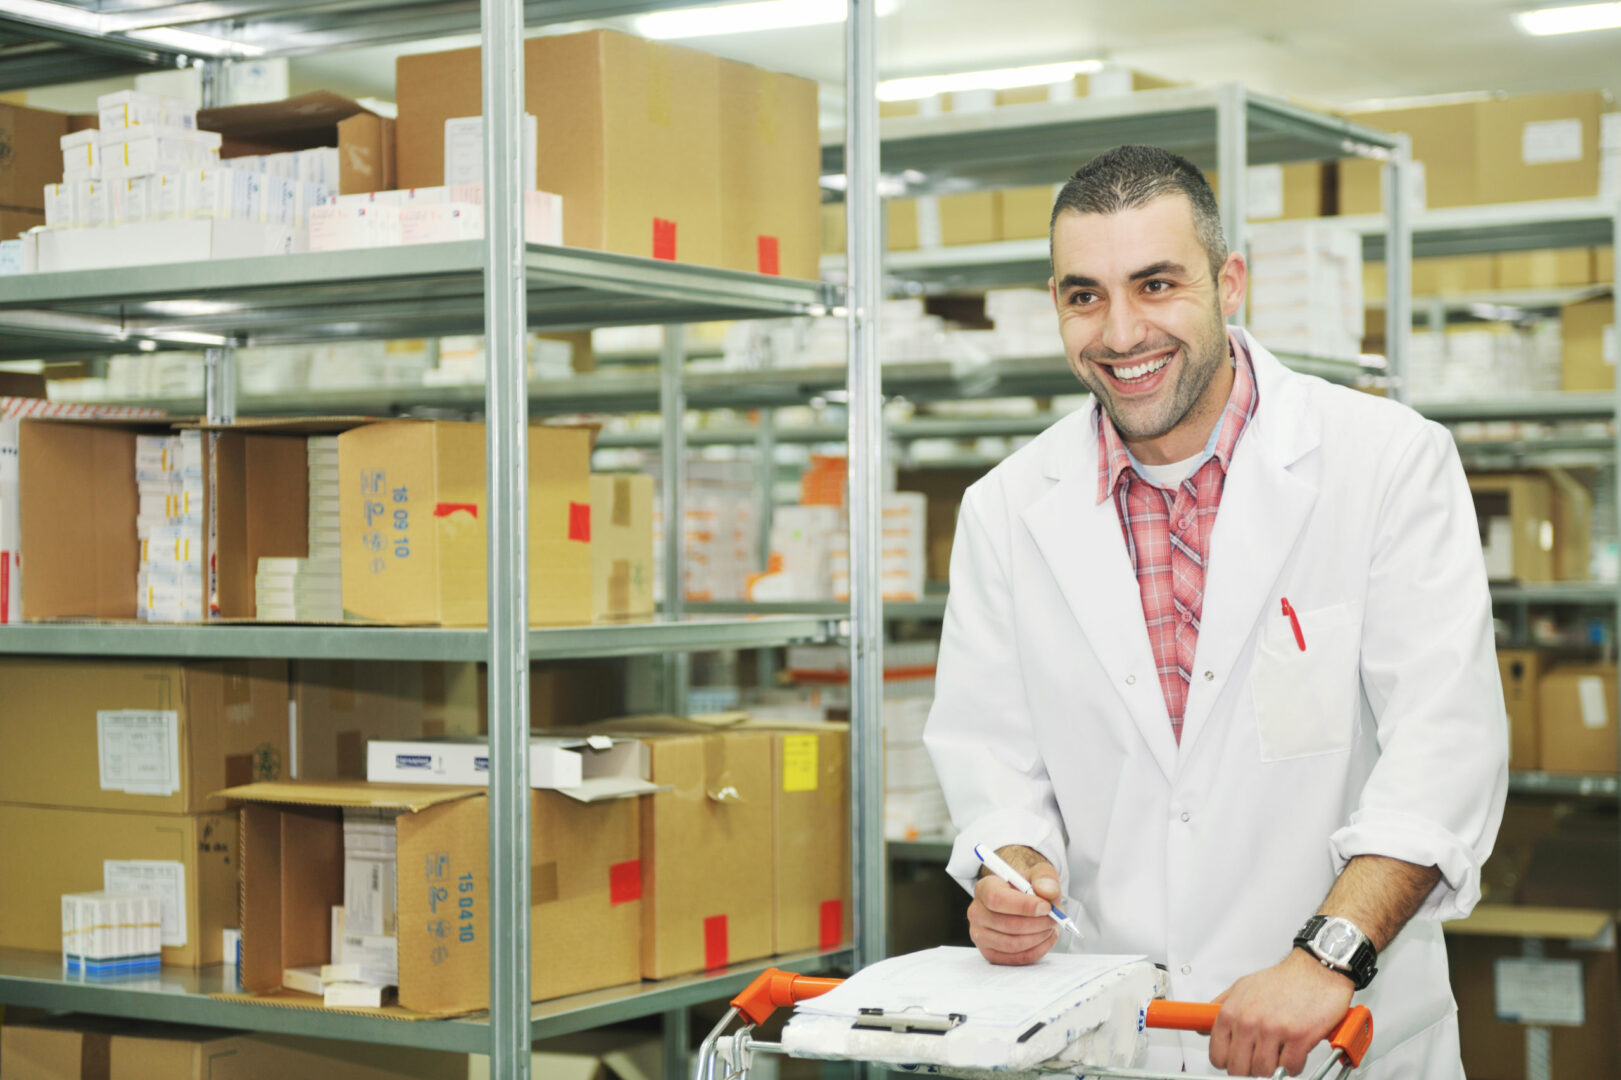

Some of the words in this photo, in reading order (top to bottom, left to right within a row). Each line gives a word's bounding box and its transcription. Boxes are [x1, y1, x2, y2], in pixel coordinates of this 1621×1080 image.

[392, 485, 408, 503] 16
[393, 509, 409, 530] 09
[393, 536, 410, 558] 10
[458, 872, 473, 893] 15
[458, 897, 474, 921] 04
[459, 922, 475, 943] 10
